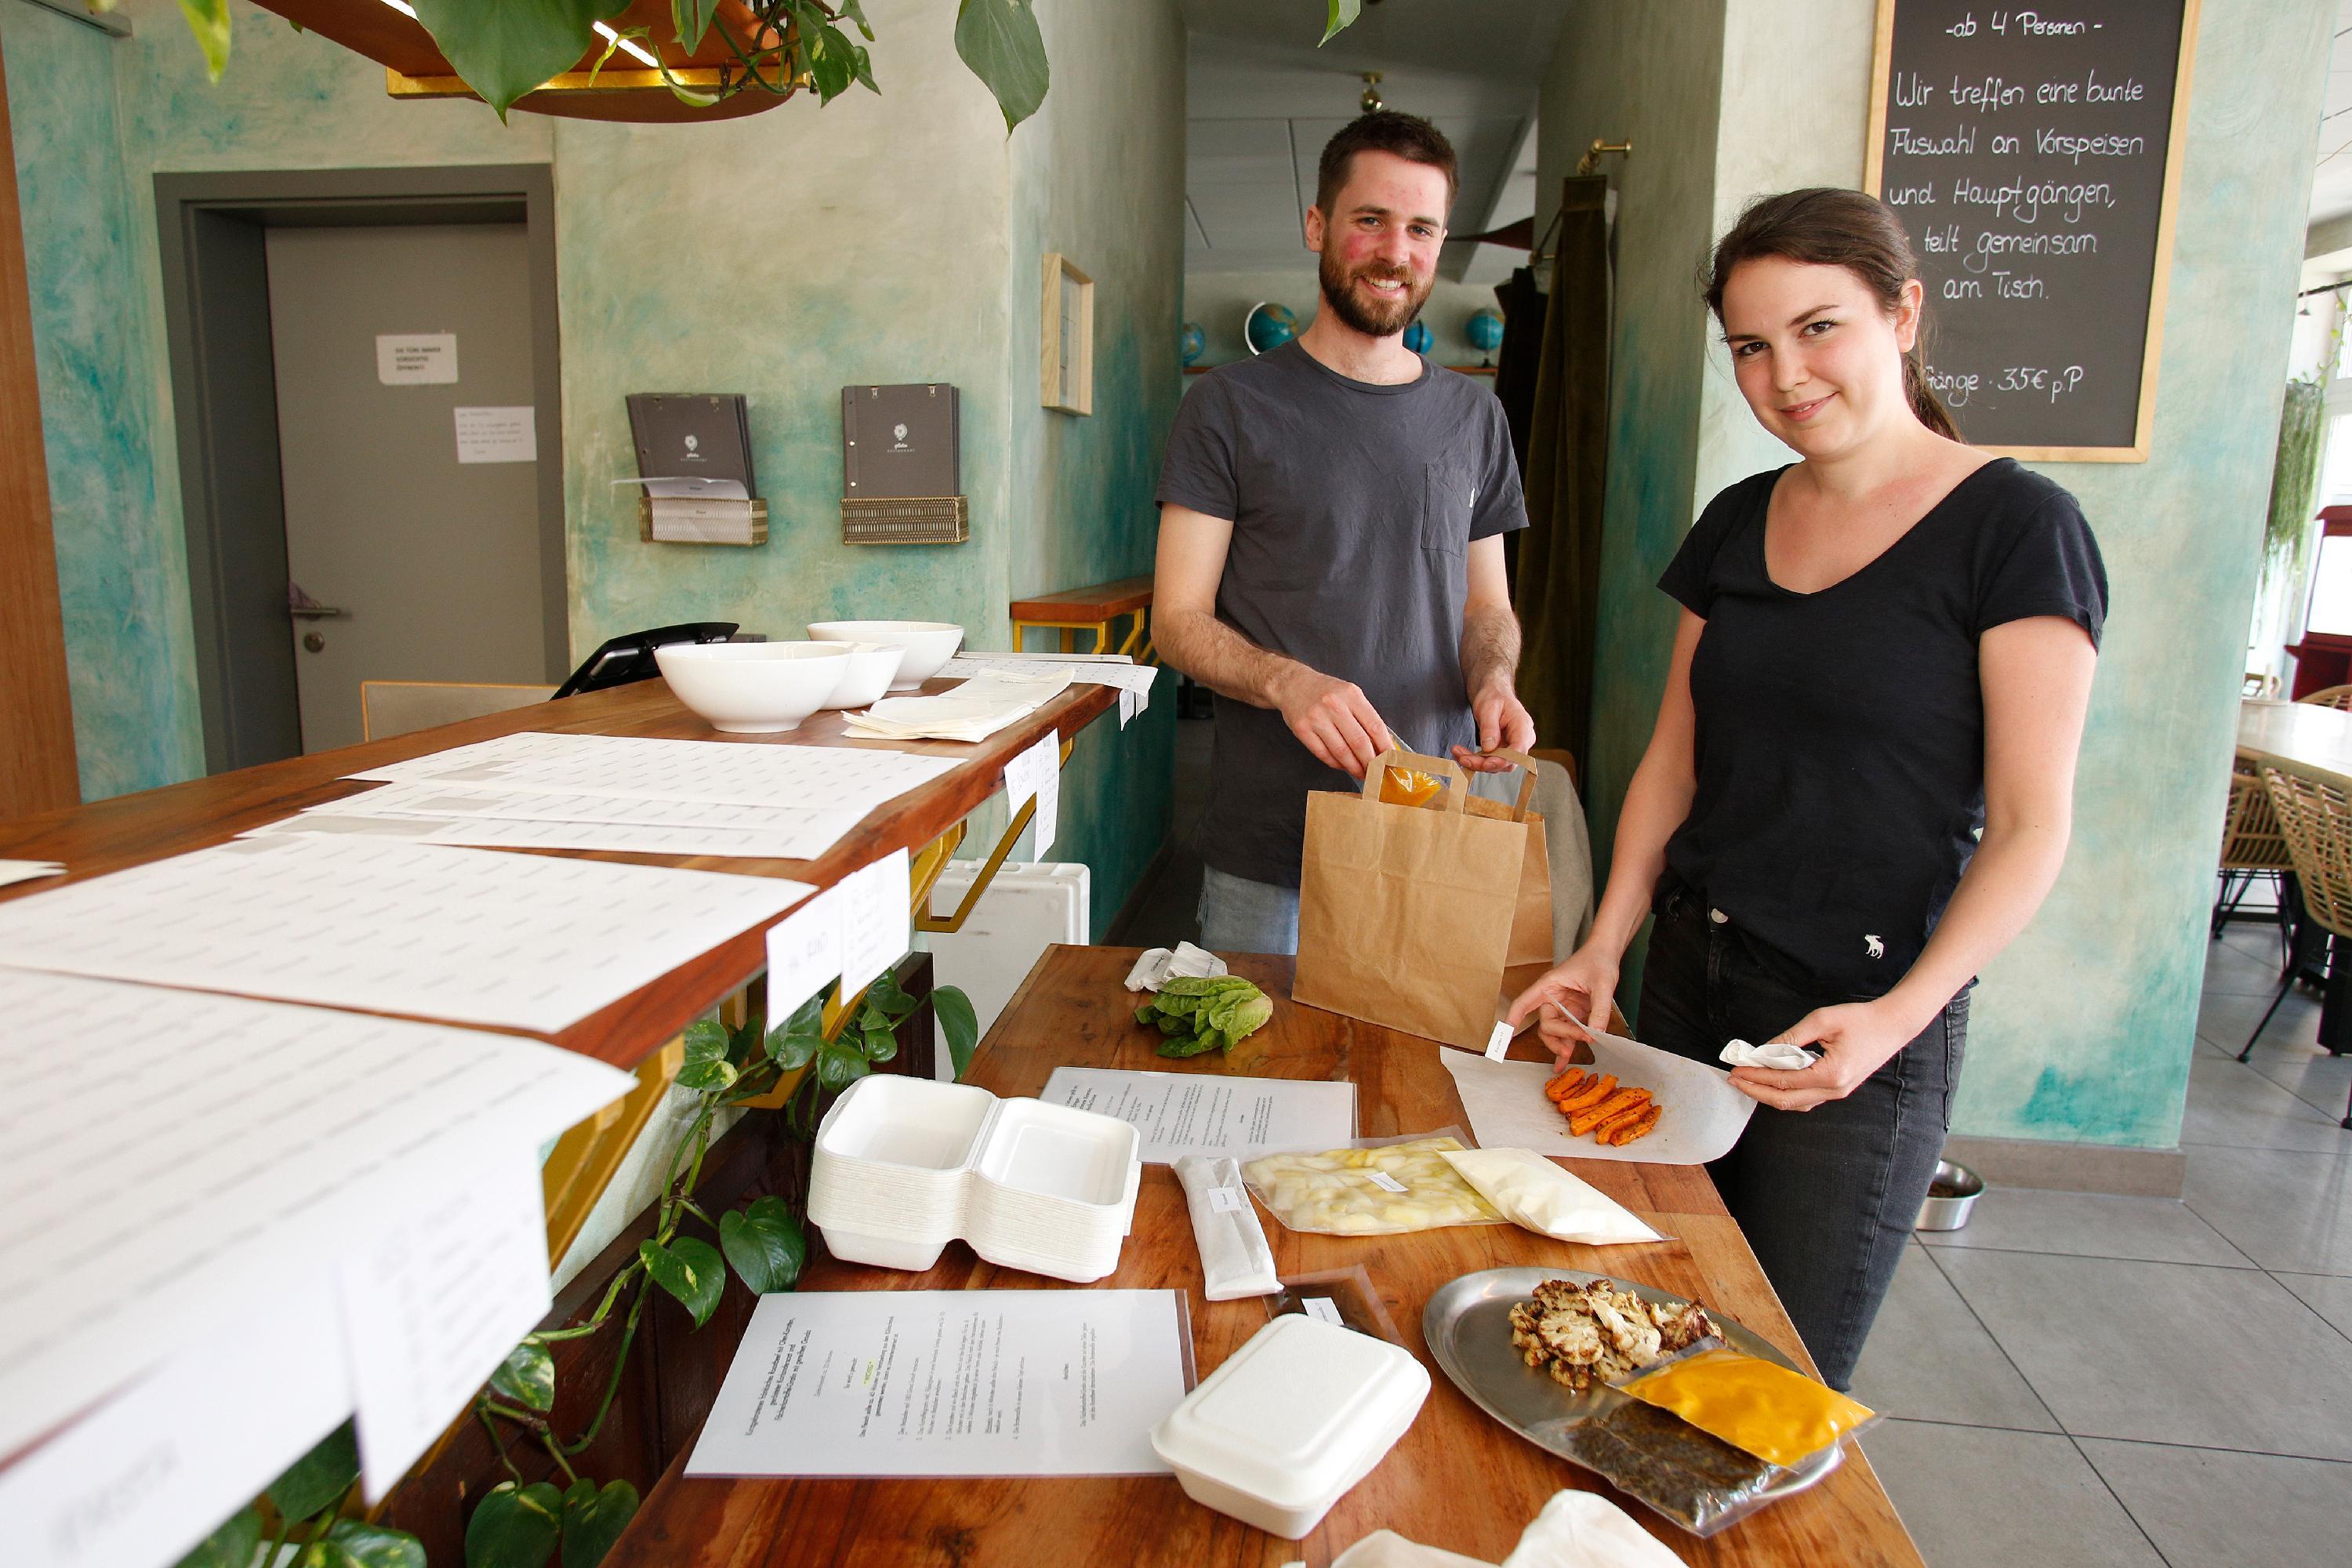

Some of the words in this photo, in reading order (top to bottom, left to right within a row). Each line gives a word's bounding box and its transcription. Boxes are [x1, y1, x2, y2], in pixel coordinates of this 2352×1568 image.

[1991, 11, 2008, 36] 4
[2015, 11, 2085, 36] Personen
[1895, 72, 1933, 107] Wir
[1949, 75, 2024, 113] treffen
[2036, 77, 2078, 105] eine
[2085, 69, 2144, 103] bunte
[1890, 125, 1976, 157] Auswahl
[1991, 134, 2020, 155] an
[2036, 127, 2144, 165] Vorspeisen
[1889, 181, 1936, 205] und
[1952, 175, 2117, 224] Hauptgängen,
[1925, 226, 1960, 253] teilt
[1963, 231, 2097, 274] gemeinsam
[1943, 279, 1982, 300] am
[1991, 270, 2050, 300] Tisch.
[1997, 367, 2048, 390] 35€
